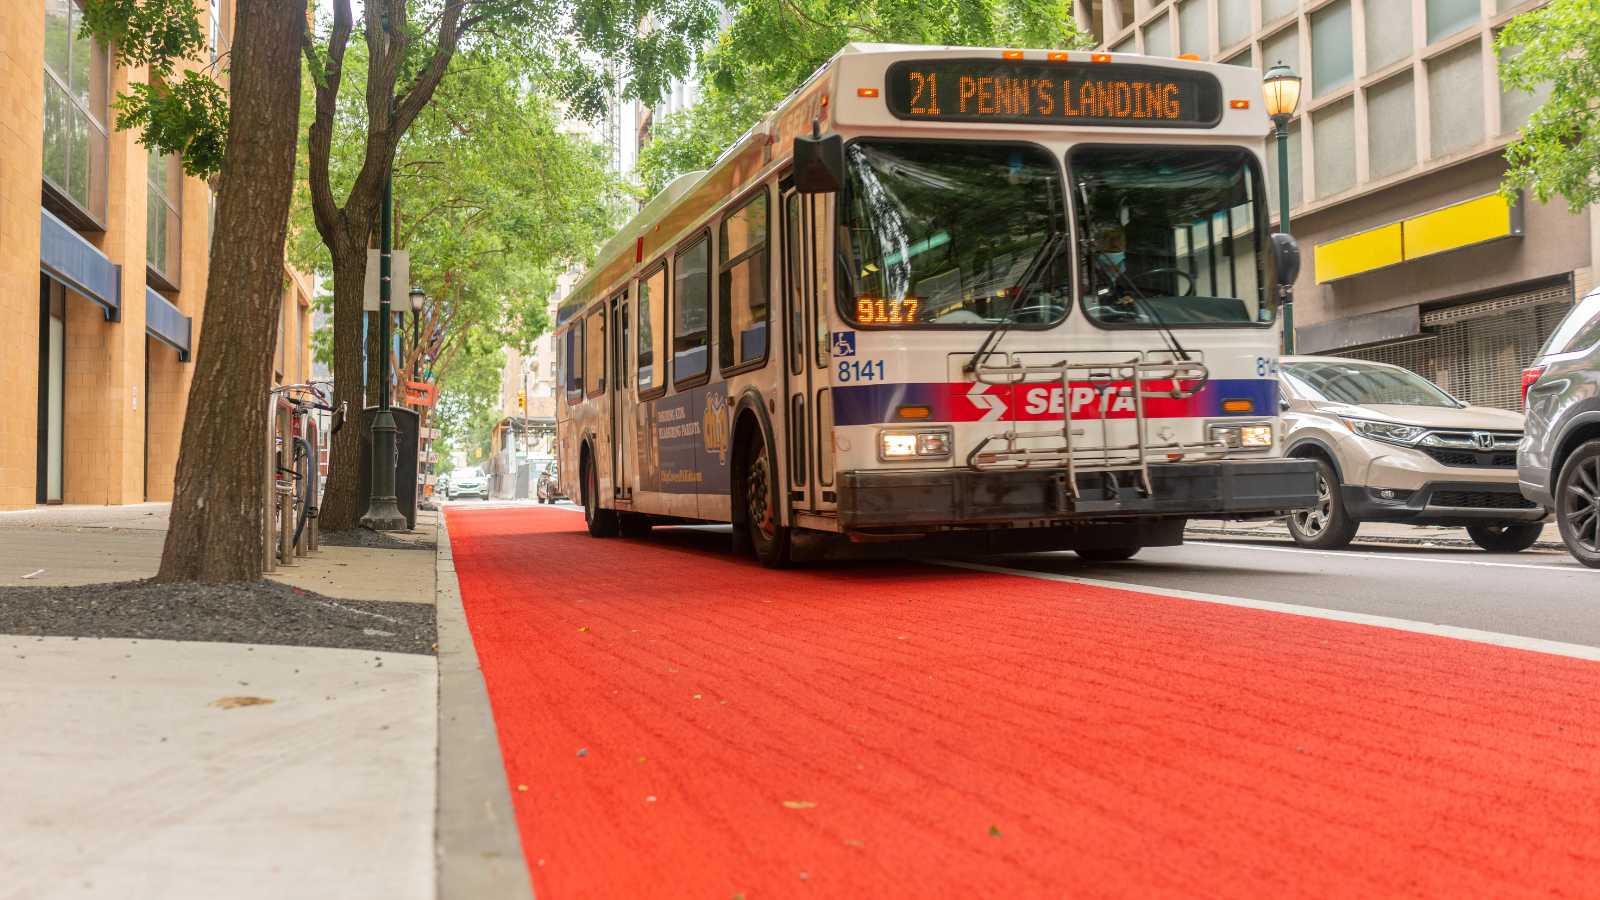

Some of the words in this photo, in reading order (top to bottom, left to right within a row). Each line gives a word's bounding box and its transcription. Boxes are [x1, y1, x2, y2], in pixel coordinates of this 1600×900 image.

[909, 72, 940, 114] 21
[959, 76, 1055, 115] PENN'S
[1063, 80, 1180, 119] LANDING
[785, 90, 822, 143] SEPTA
[858, 299, 918, 322] 9117
[837, 360, 885, 382] 8141
[1025, 387, 1136, 415] SEPTA
[659, 425, 681, 439] REASSURING
